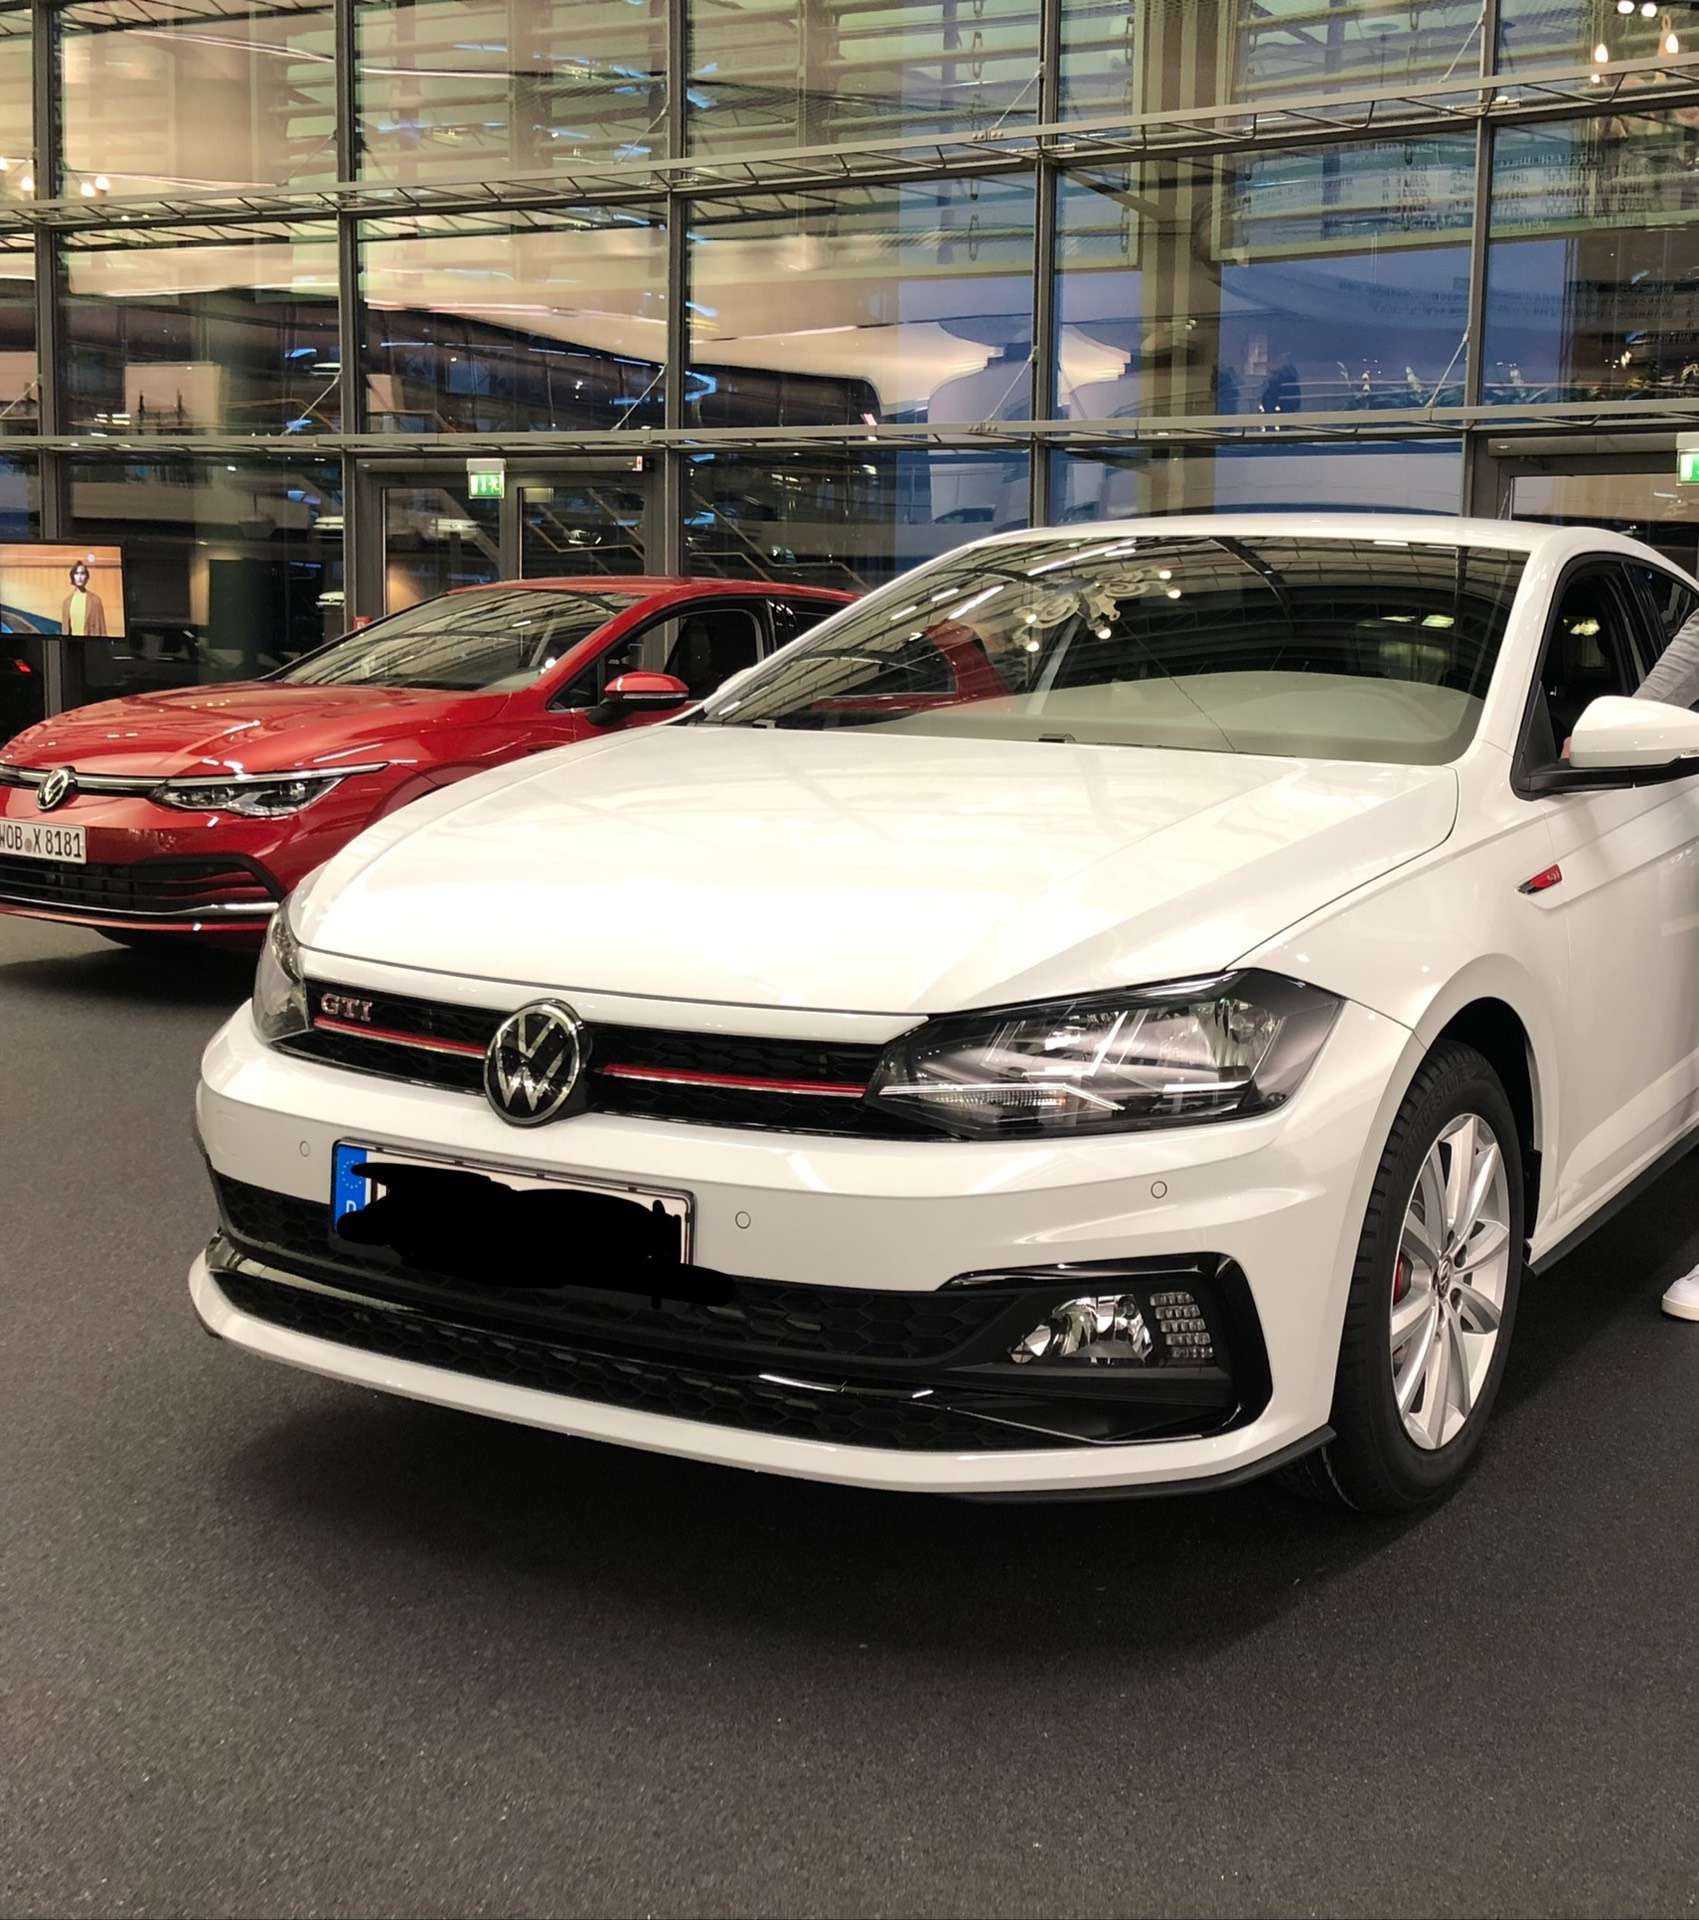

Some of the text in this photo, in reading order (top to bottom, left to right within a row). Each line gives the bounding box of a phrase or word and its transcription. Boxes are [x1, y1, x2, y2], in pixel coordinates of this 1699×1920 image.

[33, 828, 42, 854] X
[45, 829, 82, 858] 8181
[320, 992, 374, 1022] GTI
